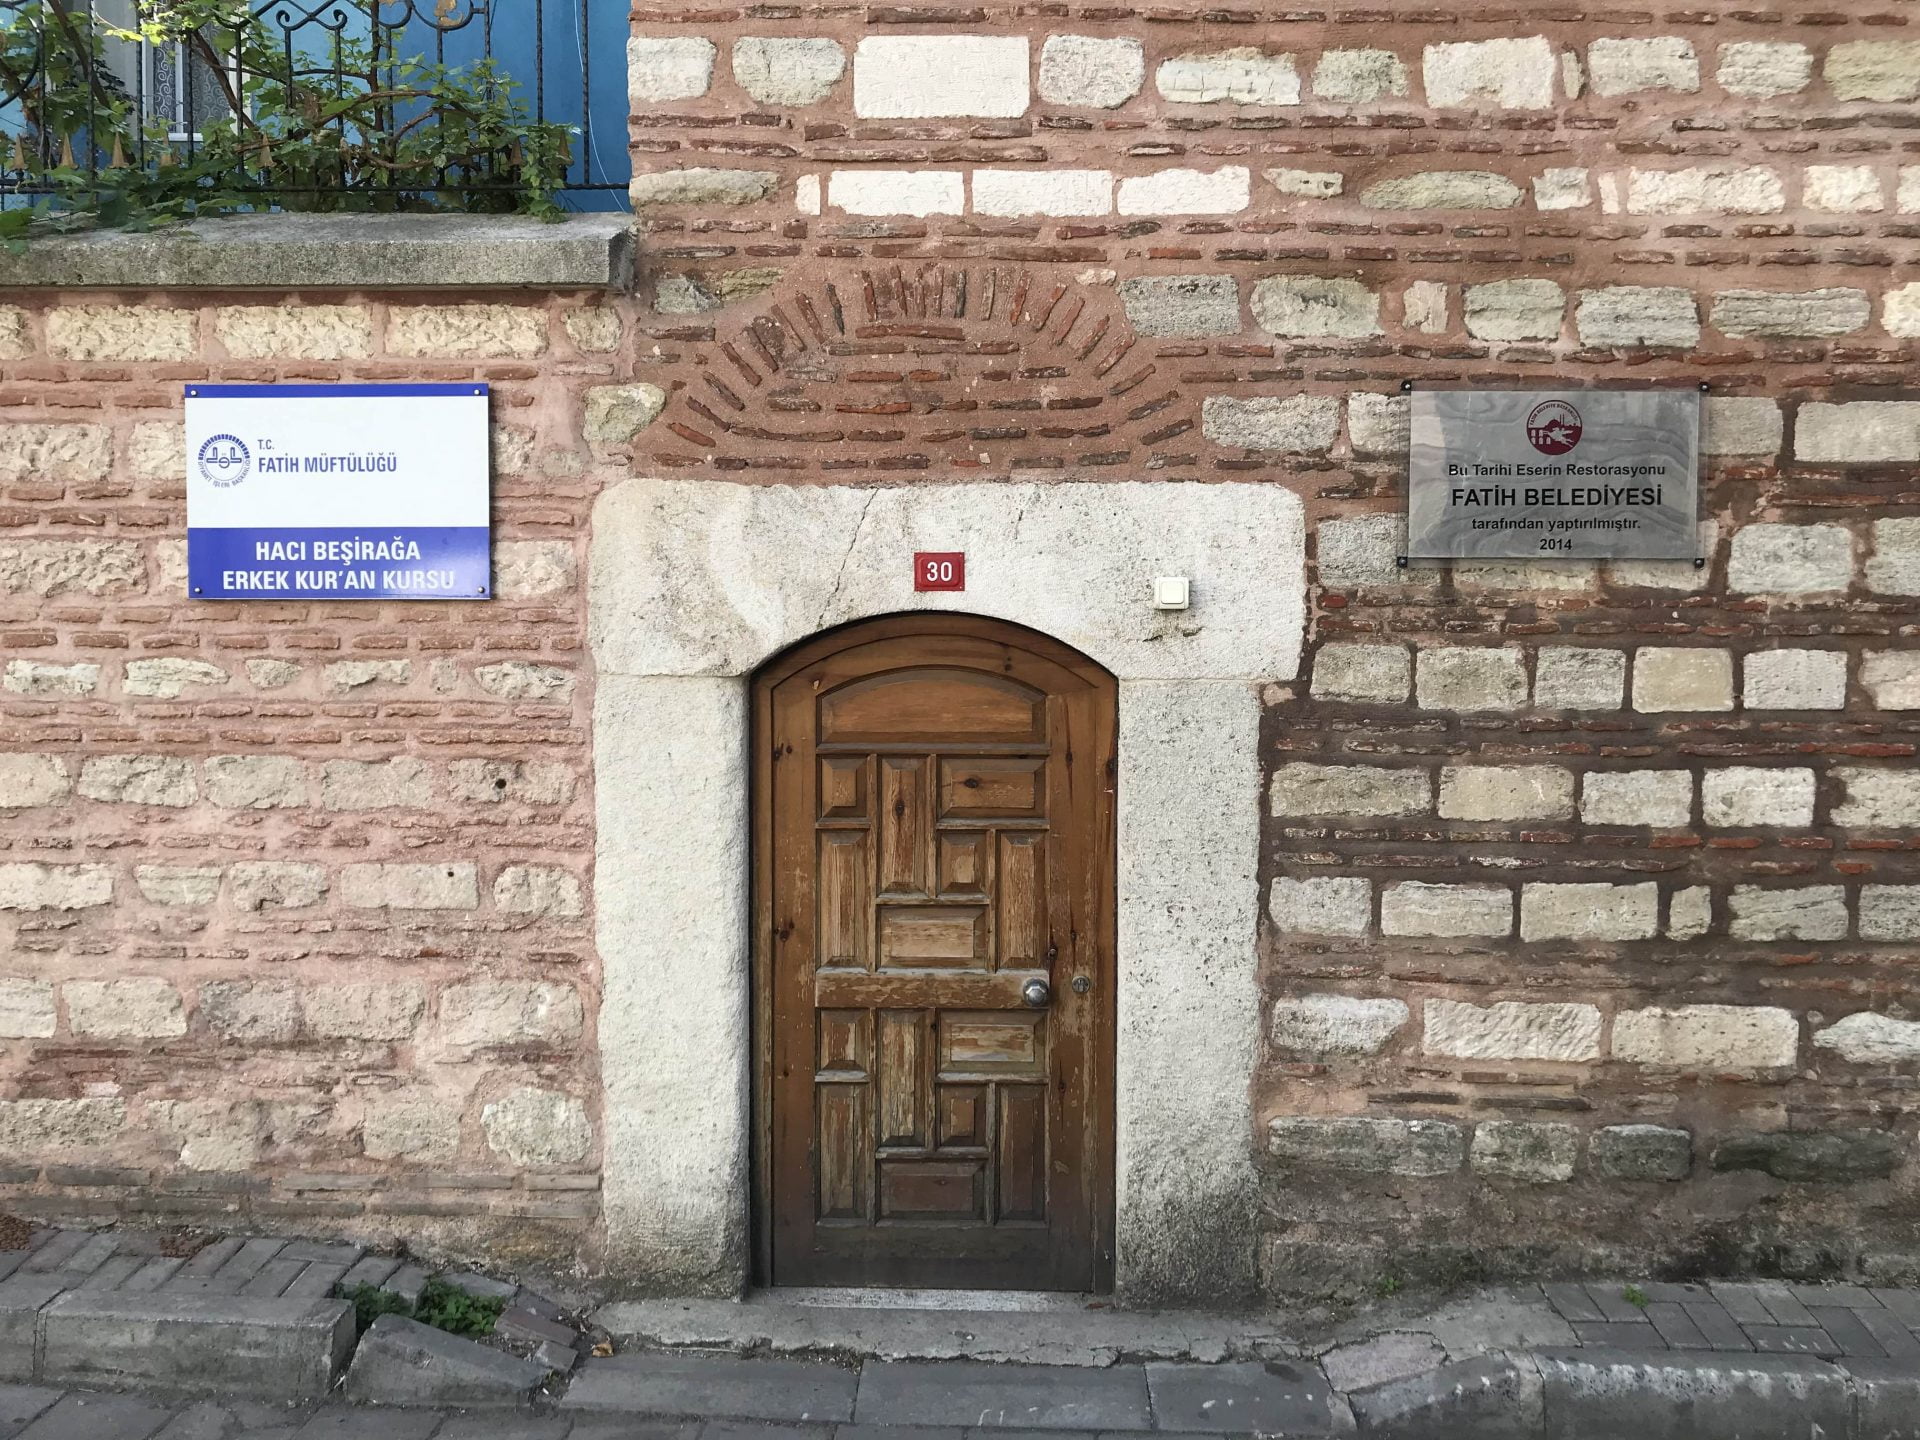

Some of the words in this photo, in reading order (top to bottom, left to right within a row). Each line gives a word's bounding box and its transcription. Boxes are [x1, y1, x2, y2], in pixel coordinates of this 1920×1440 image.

[257, 439, 274, 450] T.C.
[258, 453, 299, 473] FATİH
[304, 452, 397, 473] MÜFTÜLÜĞÜ
[1449, 464, 1468, 476] Bu
[1472, 464, 1511, 476] Tarihi
[1516, 464, 1561, 476] Eserin
[1566, 464, 1665, 479] Restorasyonu
[1451, 485, 1516, 507] FATİH
[1525, 484, 1662, 506] BELEDİYESİ
[1472, 517, 1543, 530] tarafından
[1548, 517, 1641, 533] yaptırılmıştır.
[255, 541, 306, 561] HACI
[313, 536, 421, 566] BEŞİRAĞA
[1540, 538, 1572, 550] 2014
[223, 571, 289, 590] ERKEK
[295, 570, 375, 590] KUR'AN
[382, 571, 454, 590] KURSU
[926, 561, 953, 582] 30
